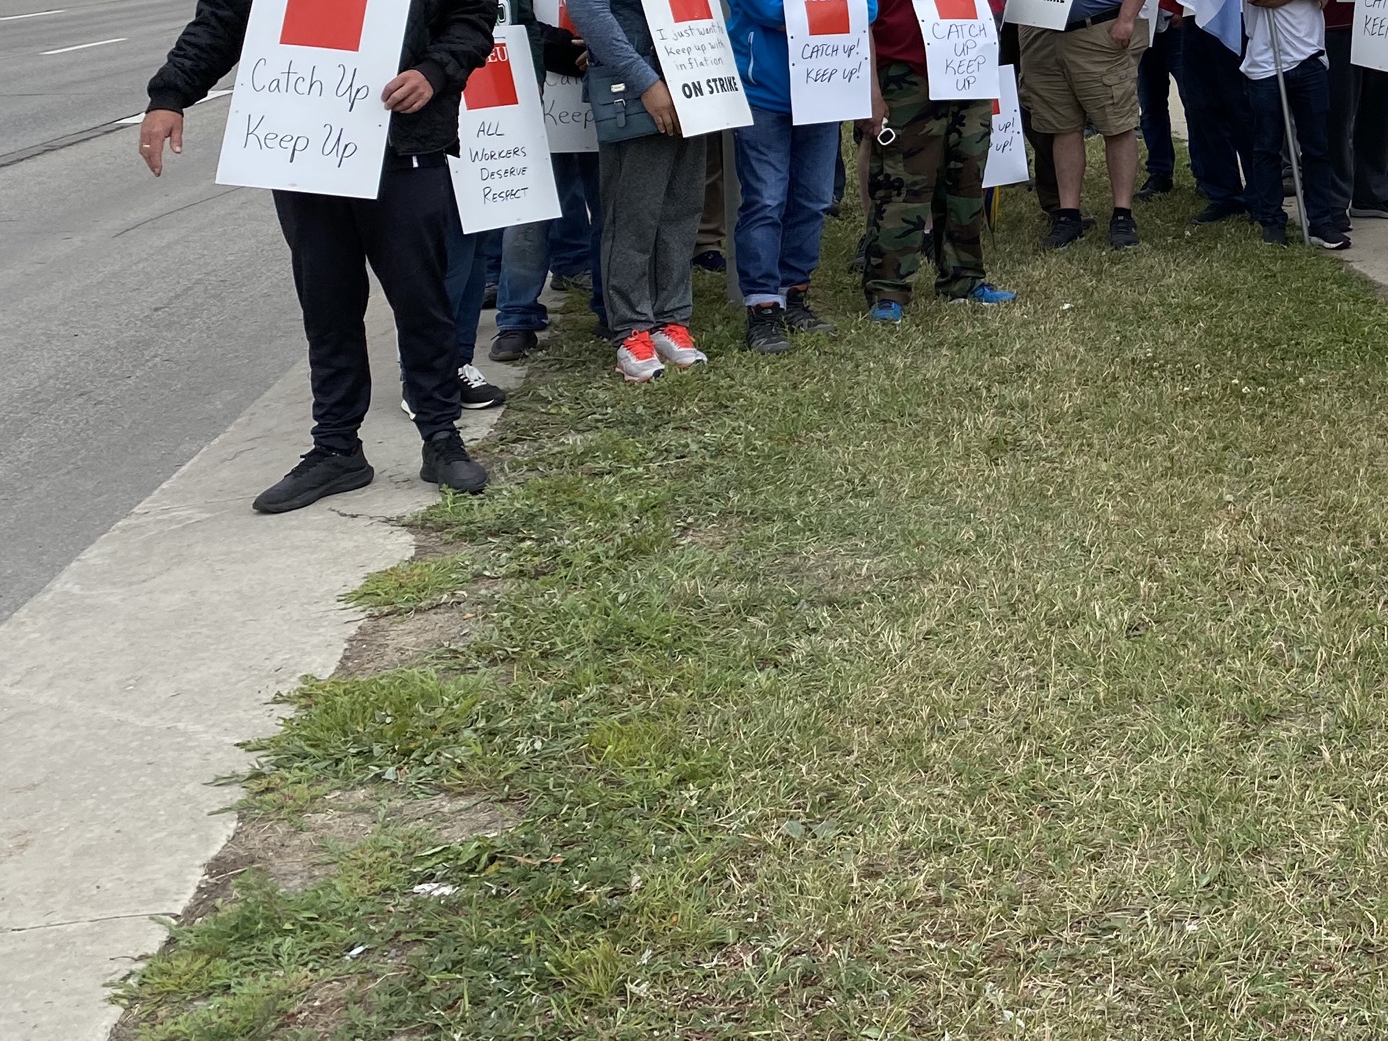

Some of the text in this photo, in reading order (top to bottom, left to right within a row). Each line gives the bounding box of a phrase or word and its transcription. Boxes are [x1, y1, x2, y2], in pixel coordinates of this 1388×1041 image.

[656, 28, 668, 40] I
[672, 25, 694, 41] just
[697, 22, 716, 36] want
[932, 23, 987, 40] CATCH
[708, 38, 726, 49] with
[801, 43, 838, 60] CATCH
[954, 39, 977, 58] UP
[487, 45, 509, 63] EU
[945, 55, 986, 76] KEEP
[806, 67, 838, 84] KEEP
[956, 75, 977, 91] UP
[251, 58, 370, 112] Catch Up
[681, 76, 739, 99] ON STRIKE
[477, 121, 505, 137] ALL
[244, 114, 358, 168] Keep Up
[469, 147, 527, 162] WORKERS
[481, 166, 528, 181] DESERVE
[483, 187, 529, 204] RESPECT
